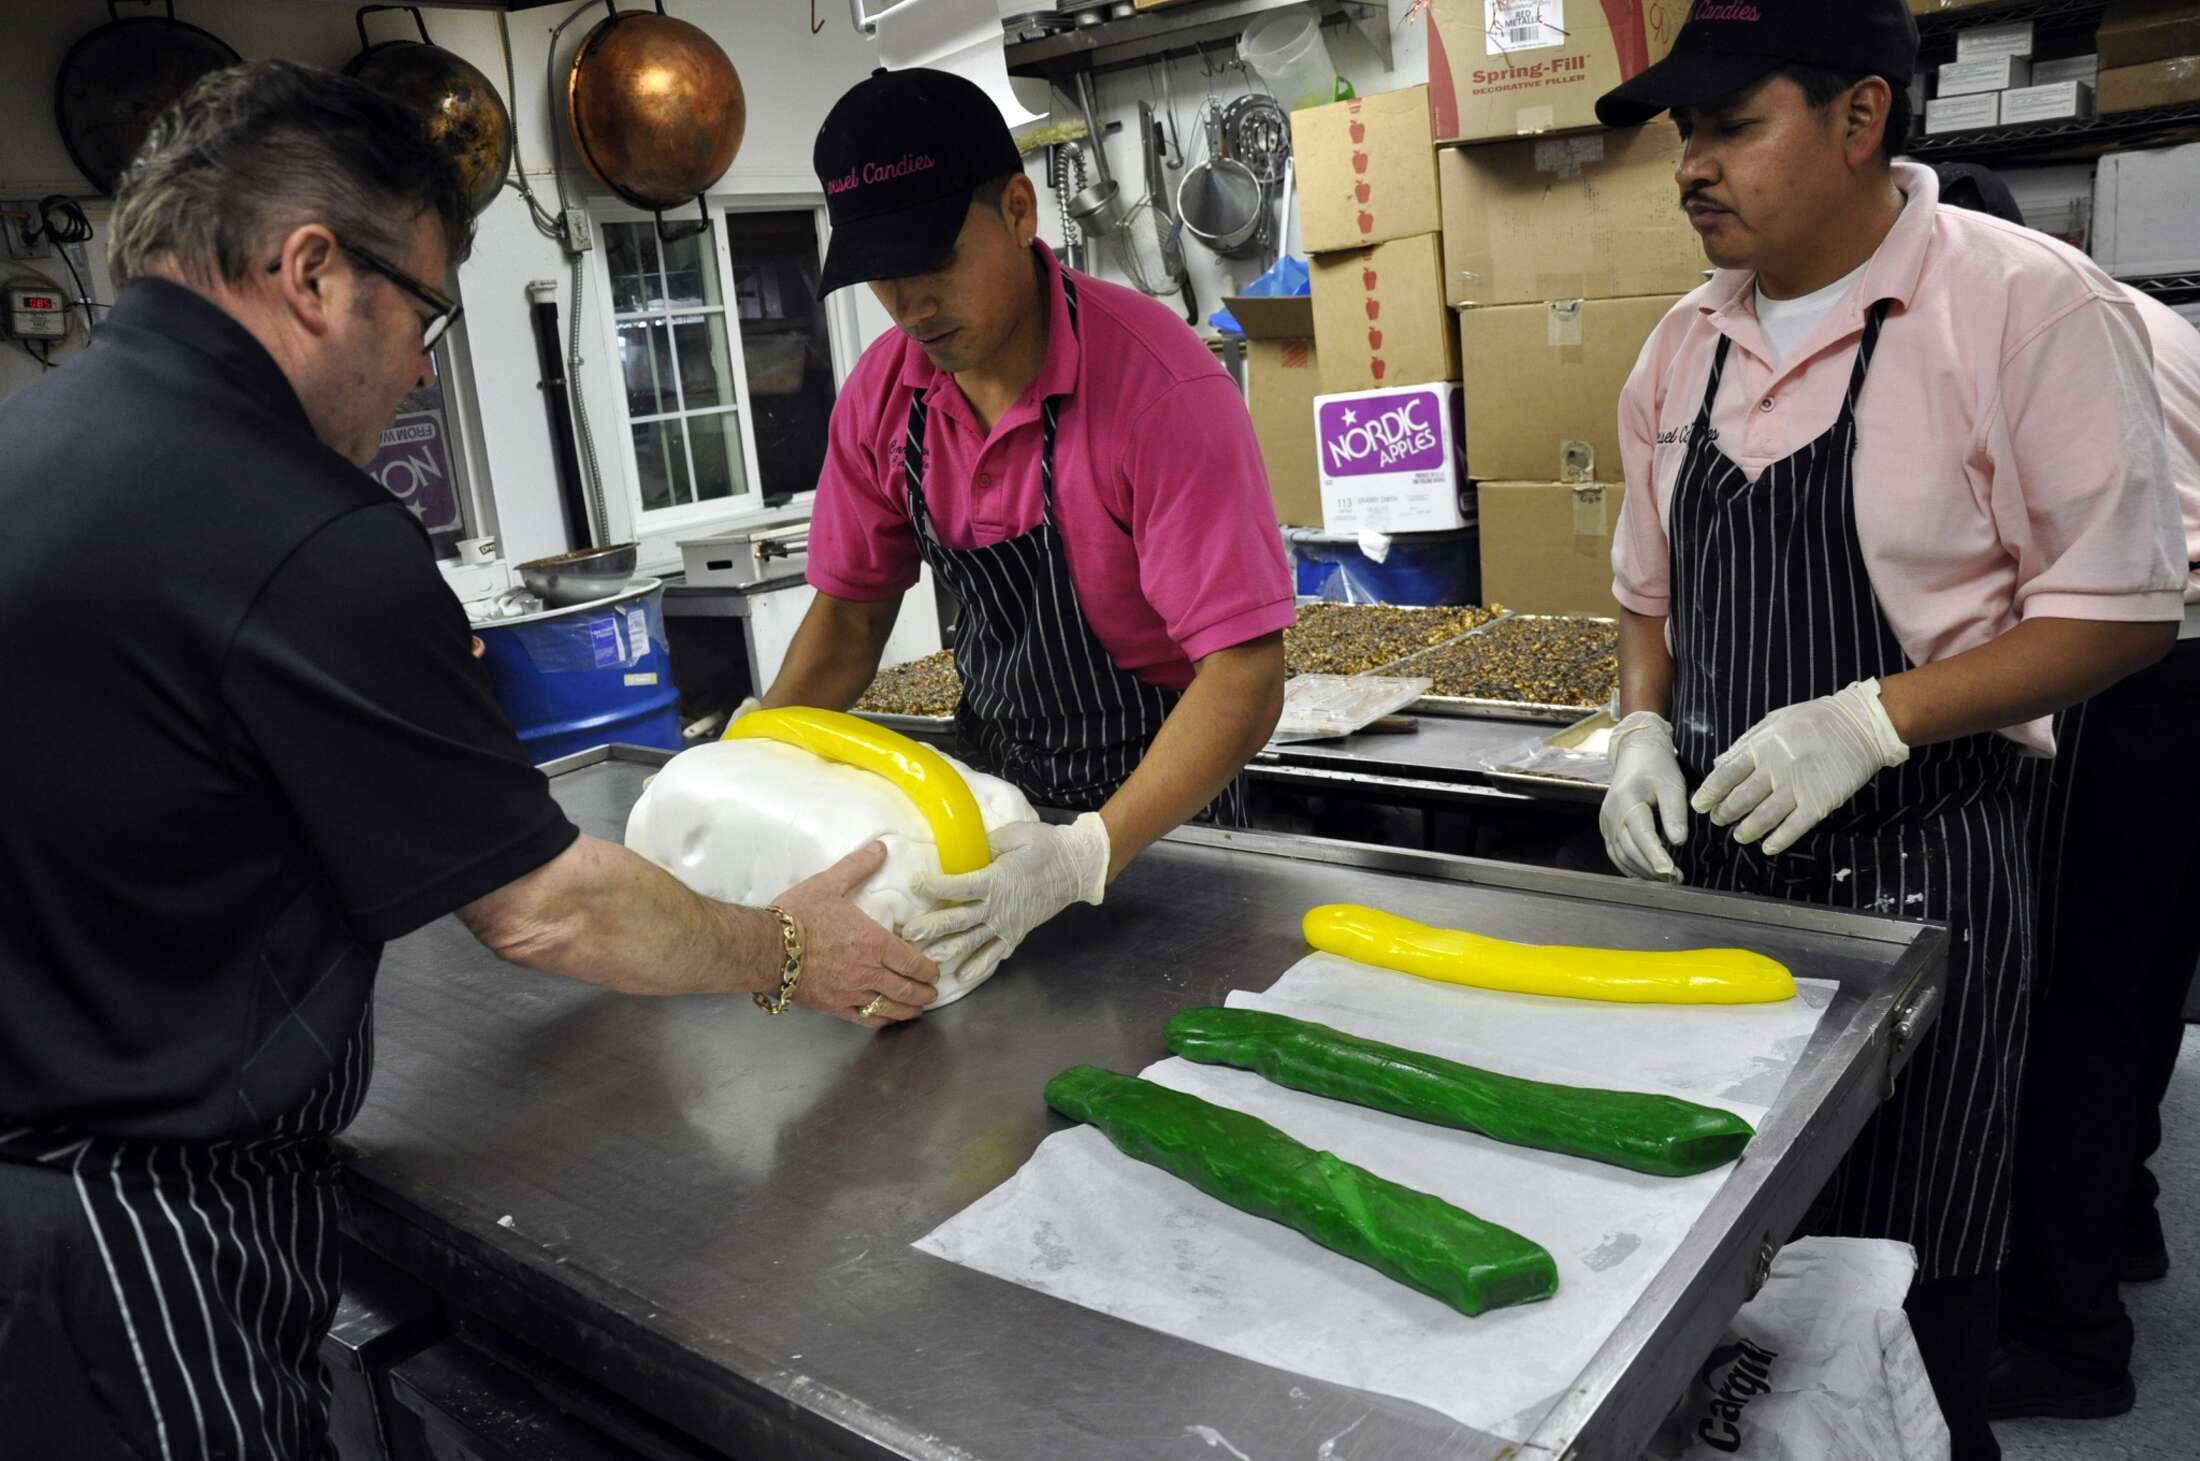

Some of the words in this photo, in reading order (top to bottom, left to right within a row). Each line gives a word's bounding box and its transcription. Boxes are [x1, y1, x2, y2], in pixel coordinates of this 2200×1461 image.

[1515, 9, 1532, 18] RED
[1471, 55, 1585, 85] Spring-Fill
[1472, 79, 1543, 96] DECORATIVE
[1545, 74, 1585, 86] FILLER
[863, 153, 935, 185] Candies
[396, 425, 433, 441] FROM
[1328, 399, 1430, 468] NORDIC
[1380, 428, 1436, 468] APPLES
[369, 445, 443, 498] NO
